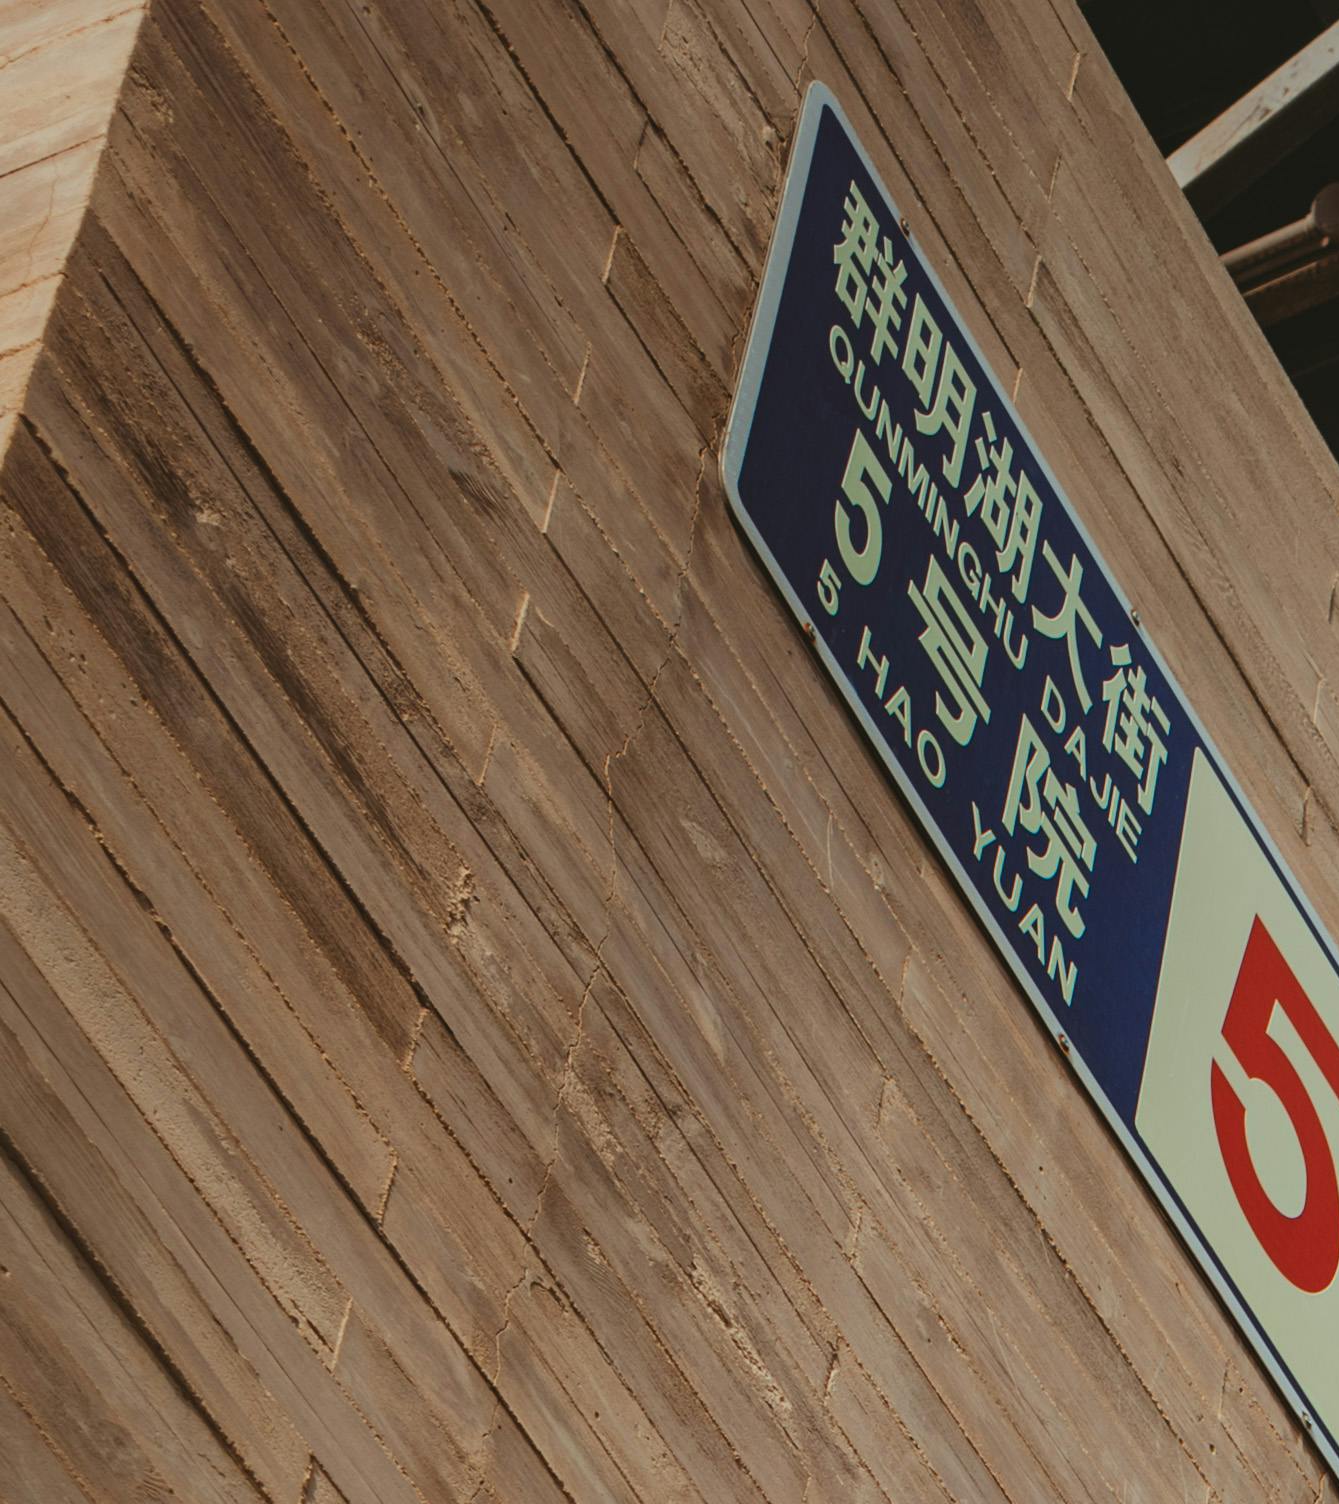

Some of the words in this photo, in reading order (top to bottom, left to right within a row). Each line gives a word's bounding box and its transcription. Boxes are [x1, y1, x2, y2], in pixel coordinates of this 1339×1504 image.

[829, 324, 1029, 670] QUNMINGHU
[1040, 674, 1142, 863] DAJIE
[833, 179, 1171, 816] 群明湖大街
[817, 558, 842, 616] 5
[856, 625, 947, 789] HAO
[971, 801, 1078, 1006] YUAN
